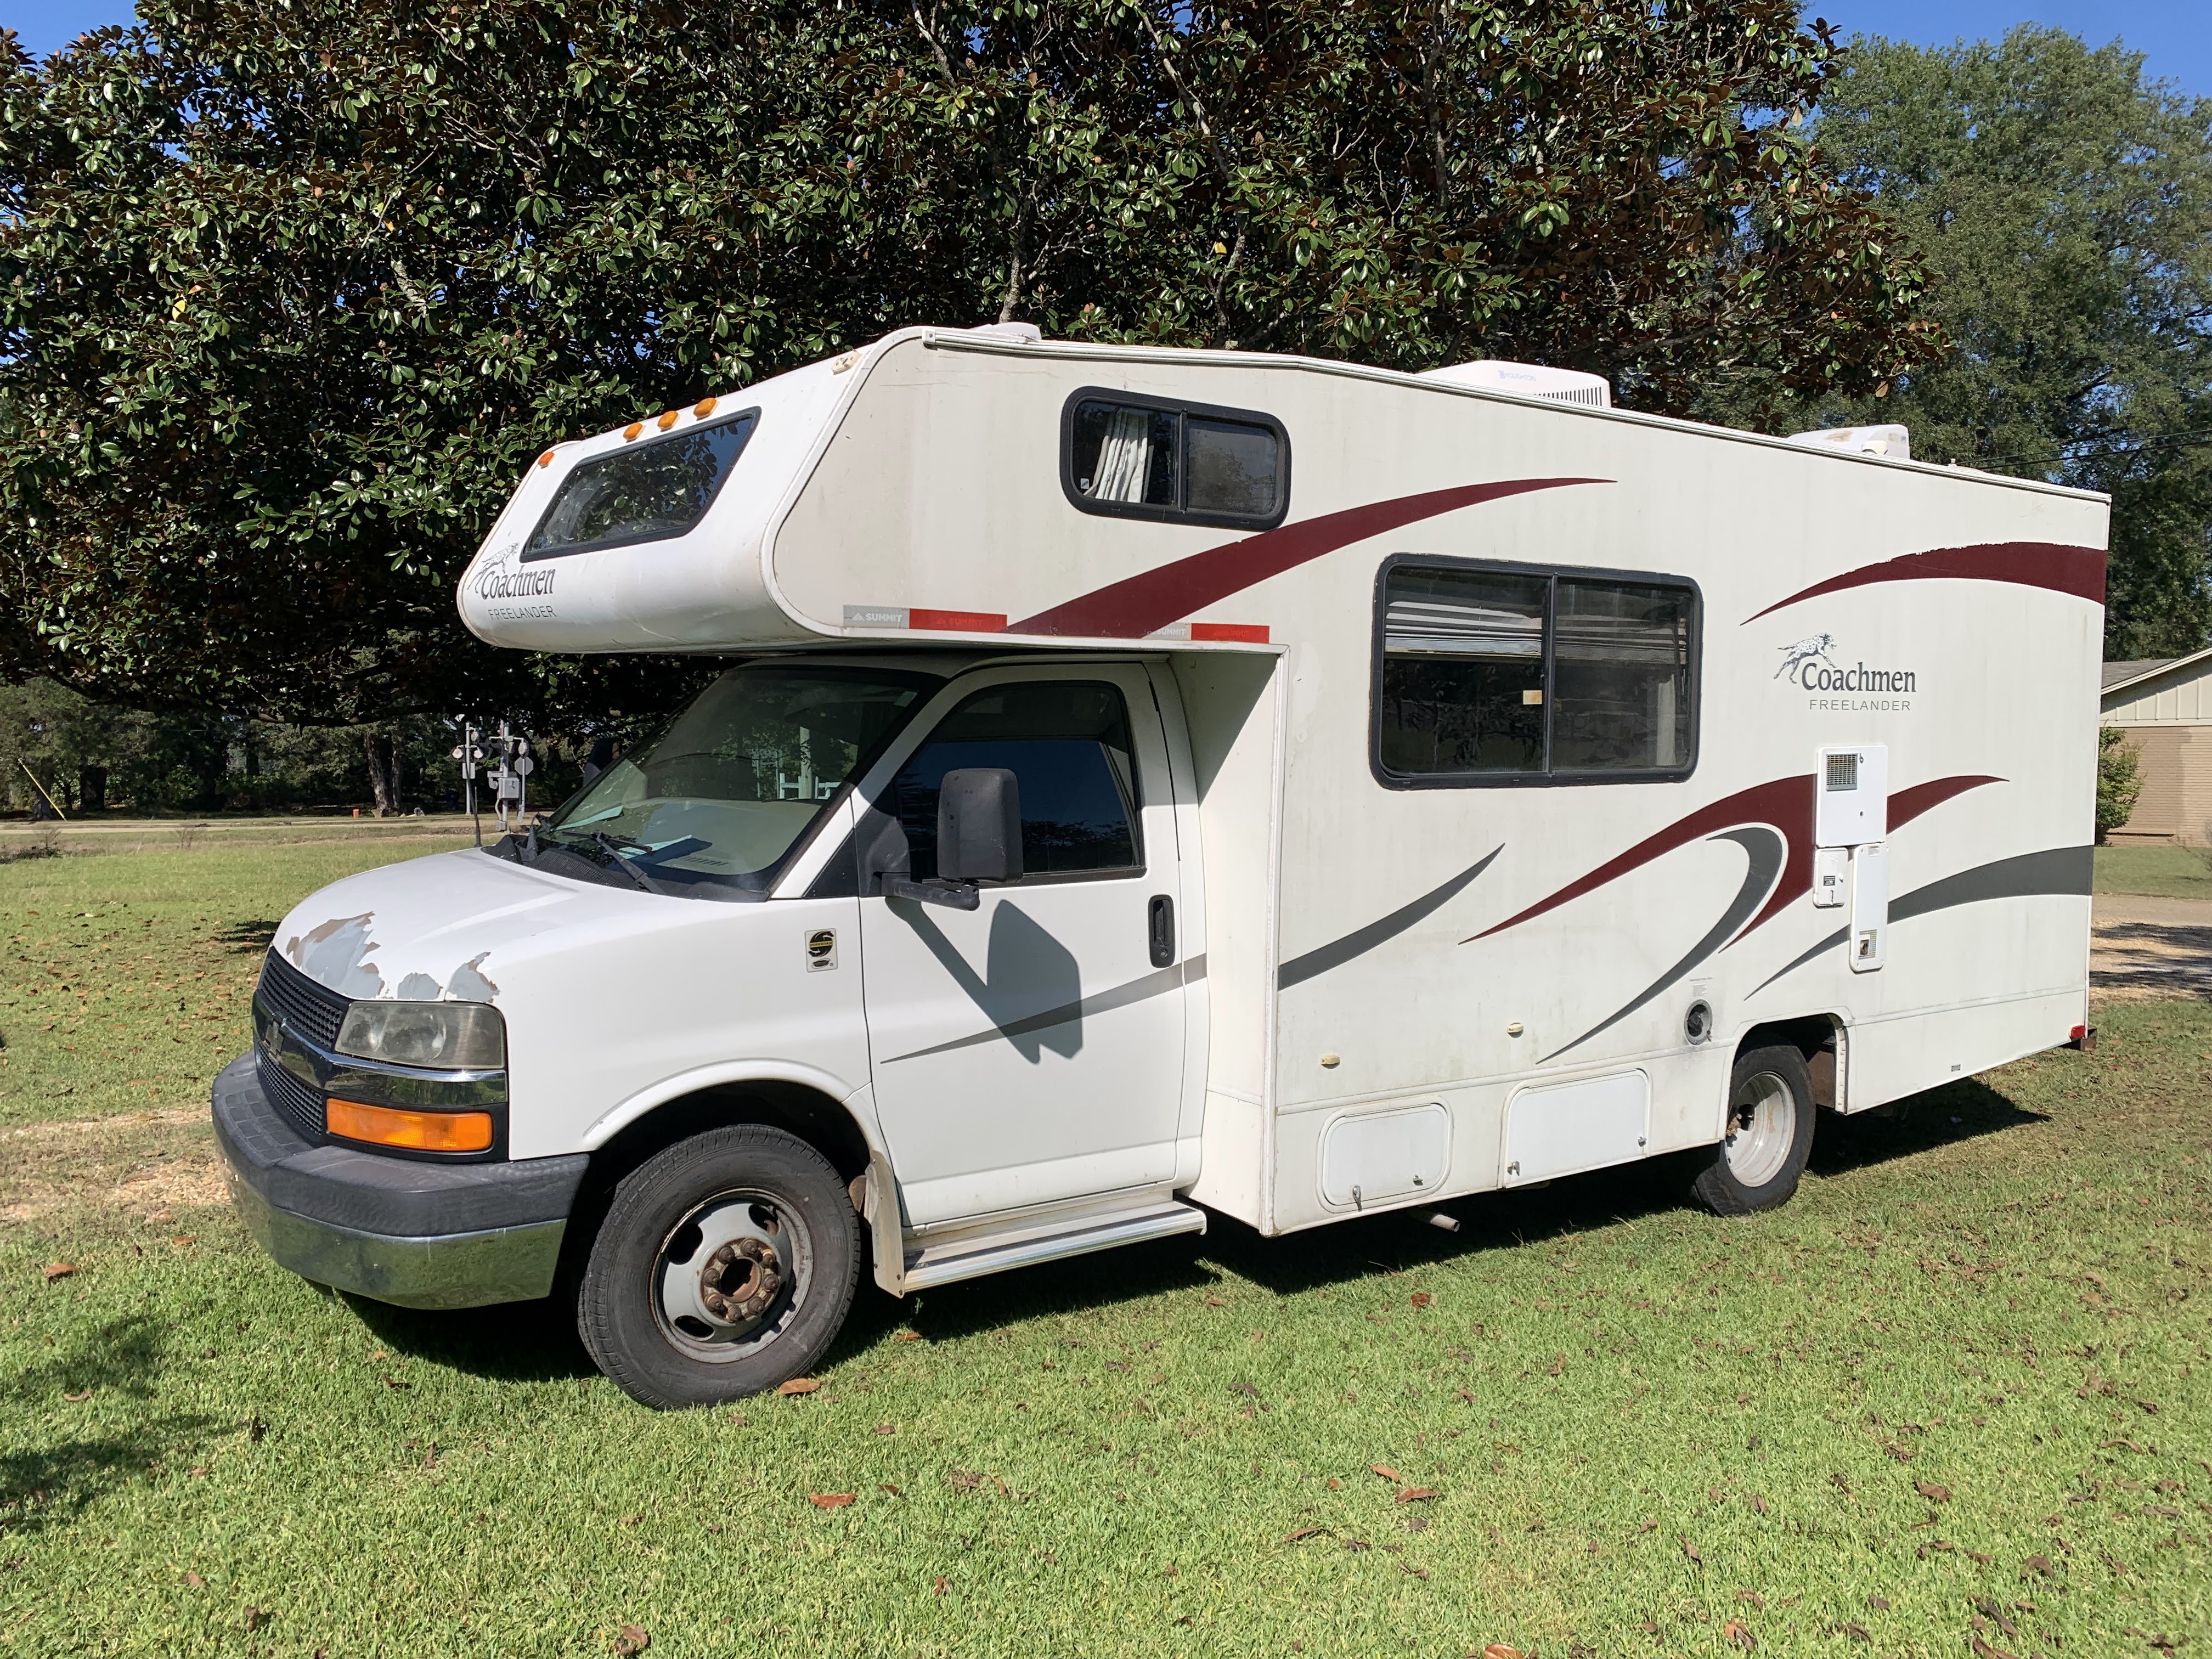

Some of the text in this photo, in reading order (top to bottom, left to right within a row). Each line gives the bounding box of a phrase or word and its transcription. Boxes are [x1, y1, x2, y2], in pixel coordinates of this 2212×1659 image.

[481, 565, 556, 600] Coachmen
[488, 606, 557, 620] FREELANDER
[865, 613, 902, 622] SUMMIT
[1157, 628, 1186, 636] SUMMIT
[1801, 661, 1916, 692] Coachmen
[1809, 699, 1910, 711] FREELANDER
